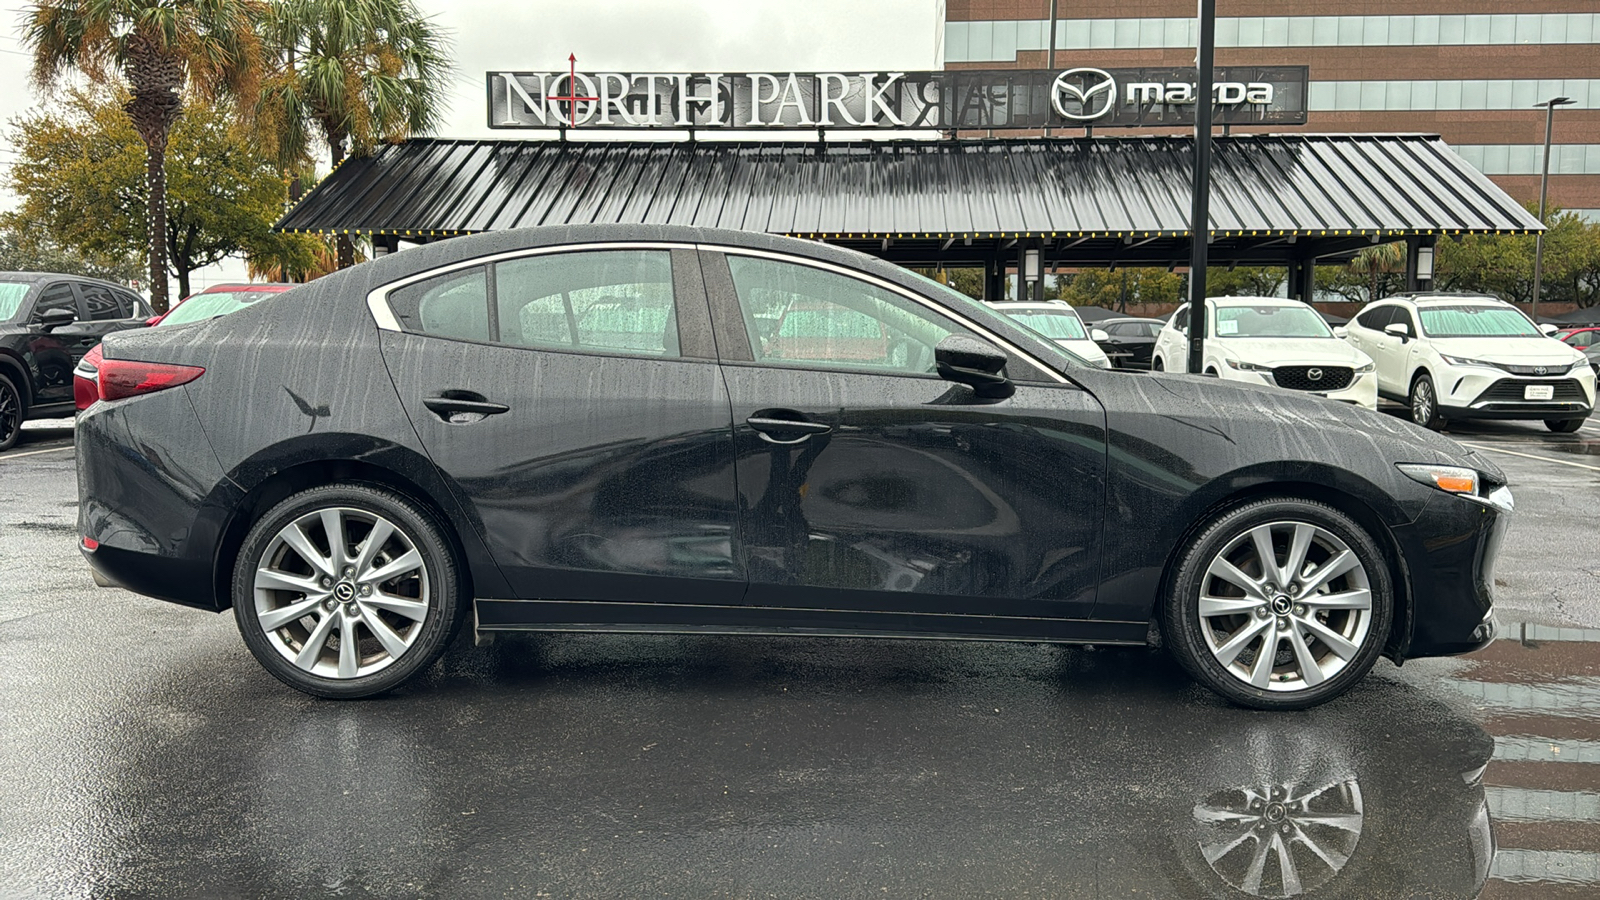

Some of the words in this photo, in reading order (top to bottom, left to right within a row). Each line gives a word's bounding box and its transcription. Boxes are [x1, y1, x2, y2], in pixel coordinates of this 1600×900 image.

[498, 72, 724, 126] NORTH
[745, 72, 906, 126] PARK
[425, 608, 443, 647] TOYO
